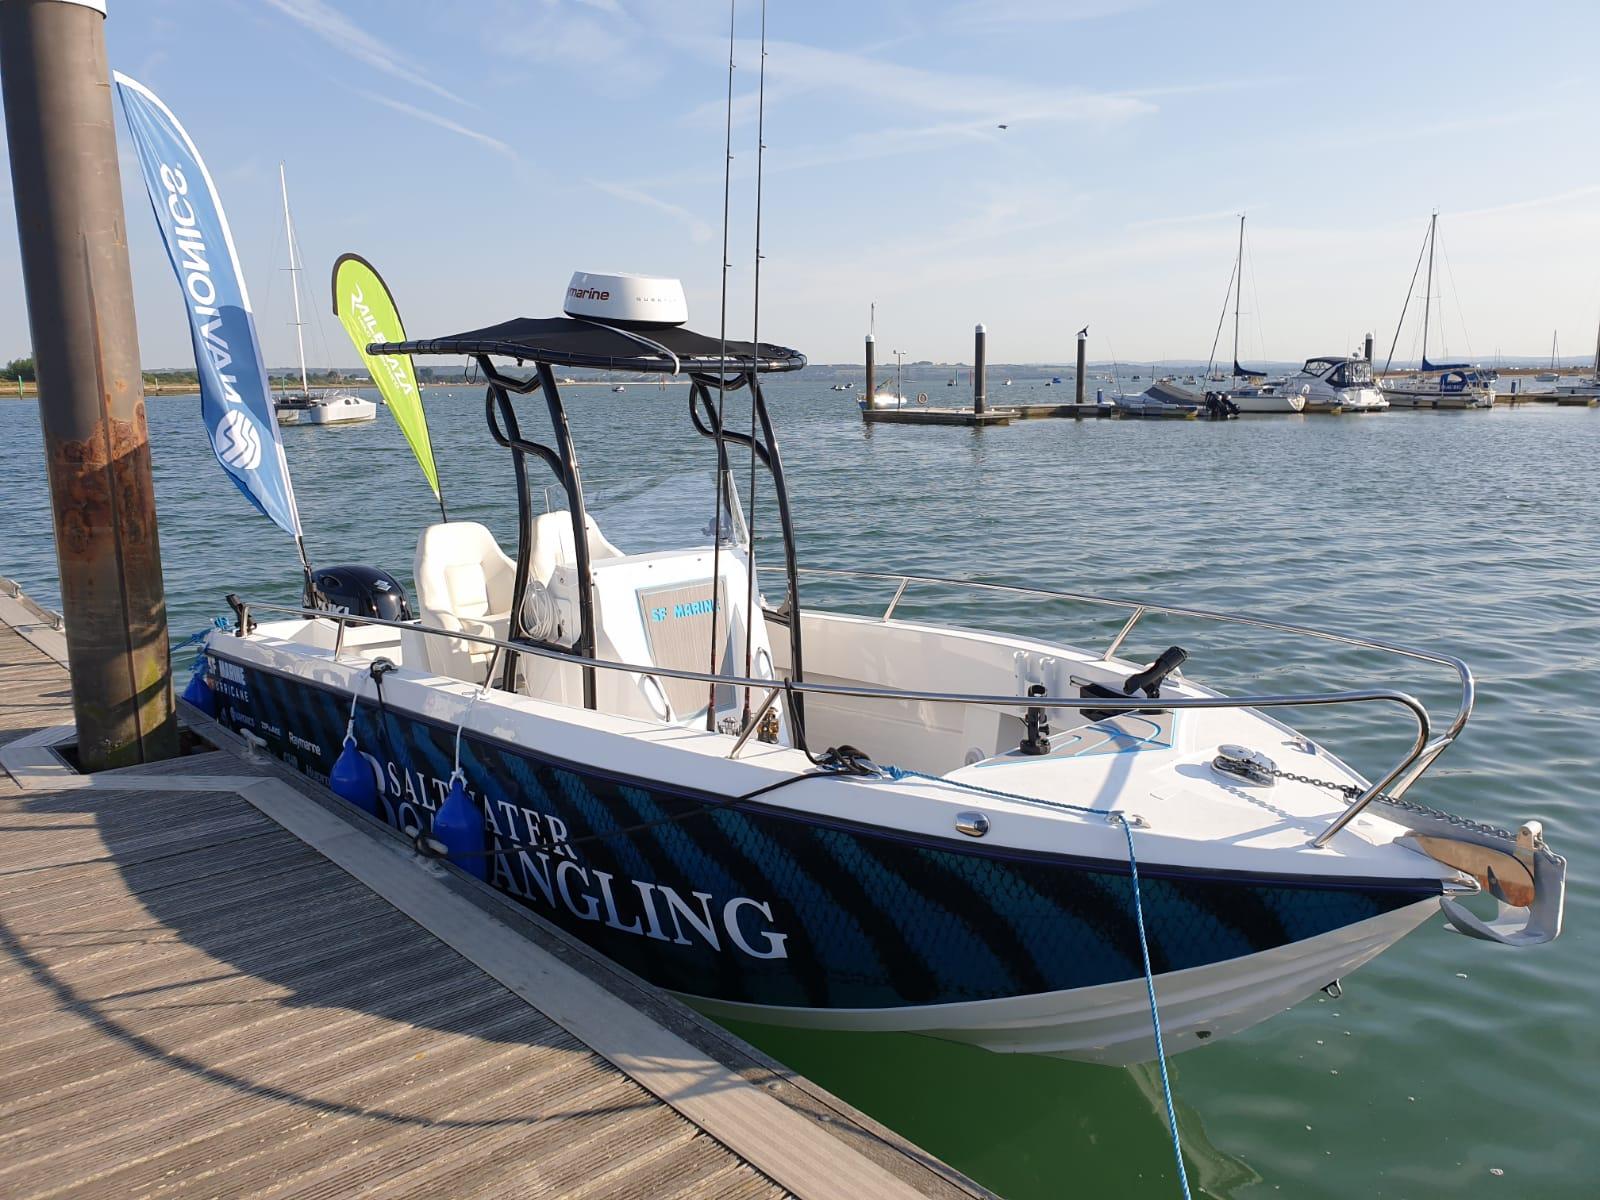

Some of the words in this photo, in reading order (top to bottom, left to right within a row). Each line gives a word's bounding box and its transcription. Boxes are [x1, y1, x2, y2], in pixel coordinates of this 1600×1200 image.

[288, 731, 321, 756] Raymarine
[387, 761, 578, 860] SALTATER
[490, 837, 789, 959] ANGLING
